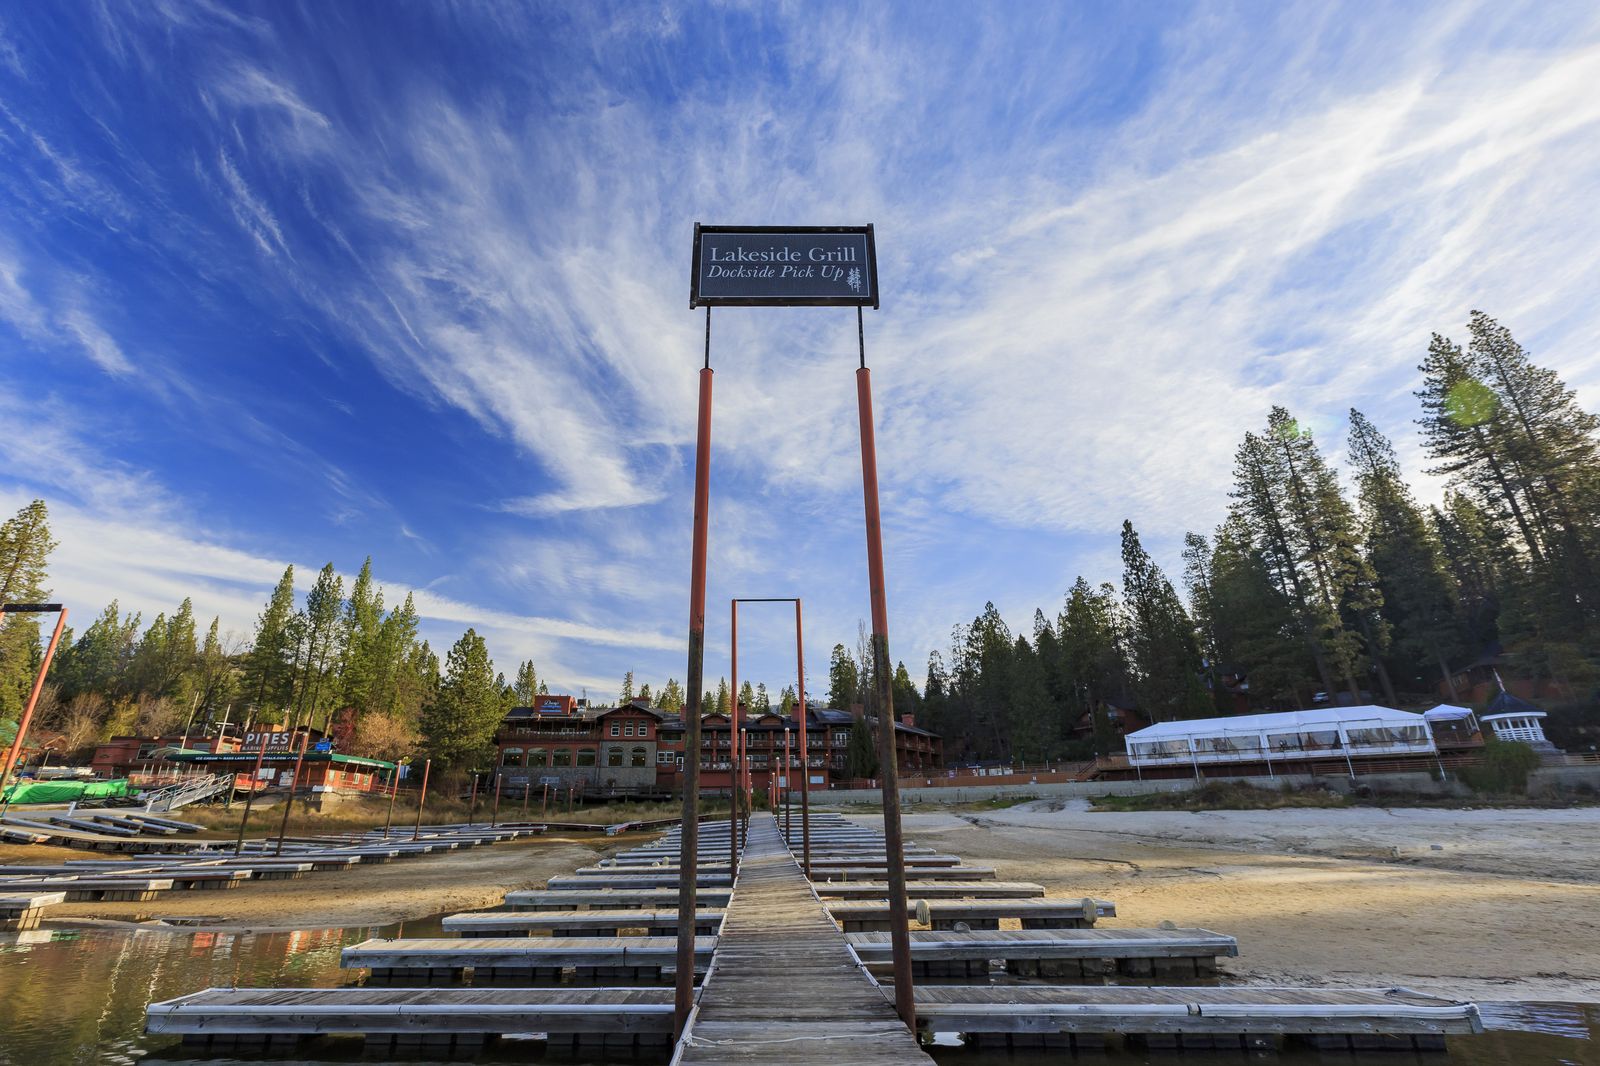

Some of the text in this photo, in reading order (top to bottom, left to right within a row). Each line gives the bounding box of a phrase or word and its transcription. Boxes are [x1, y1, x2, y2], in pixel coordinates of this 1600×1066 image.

[710, 247, 857, 262] Lakeside Grill
[707, 265, 844, 281] Dockside Pick Up
